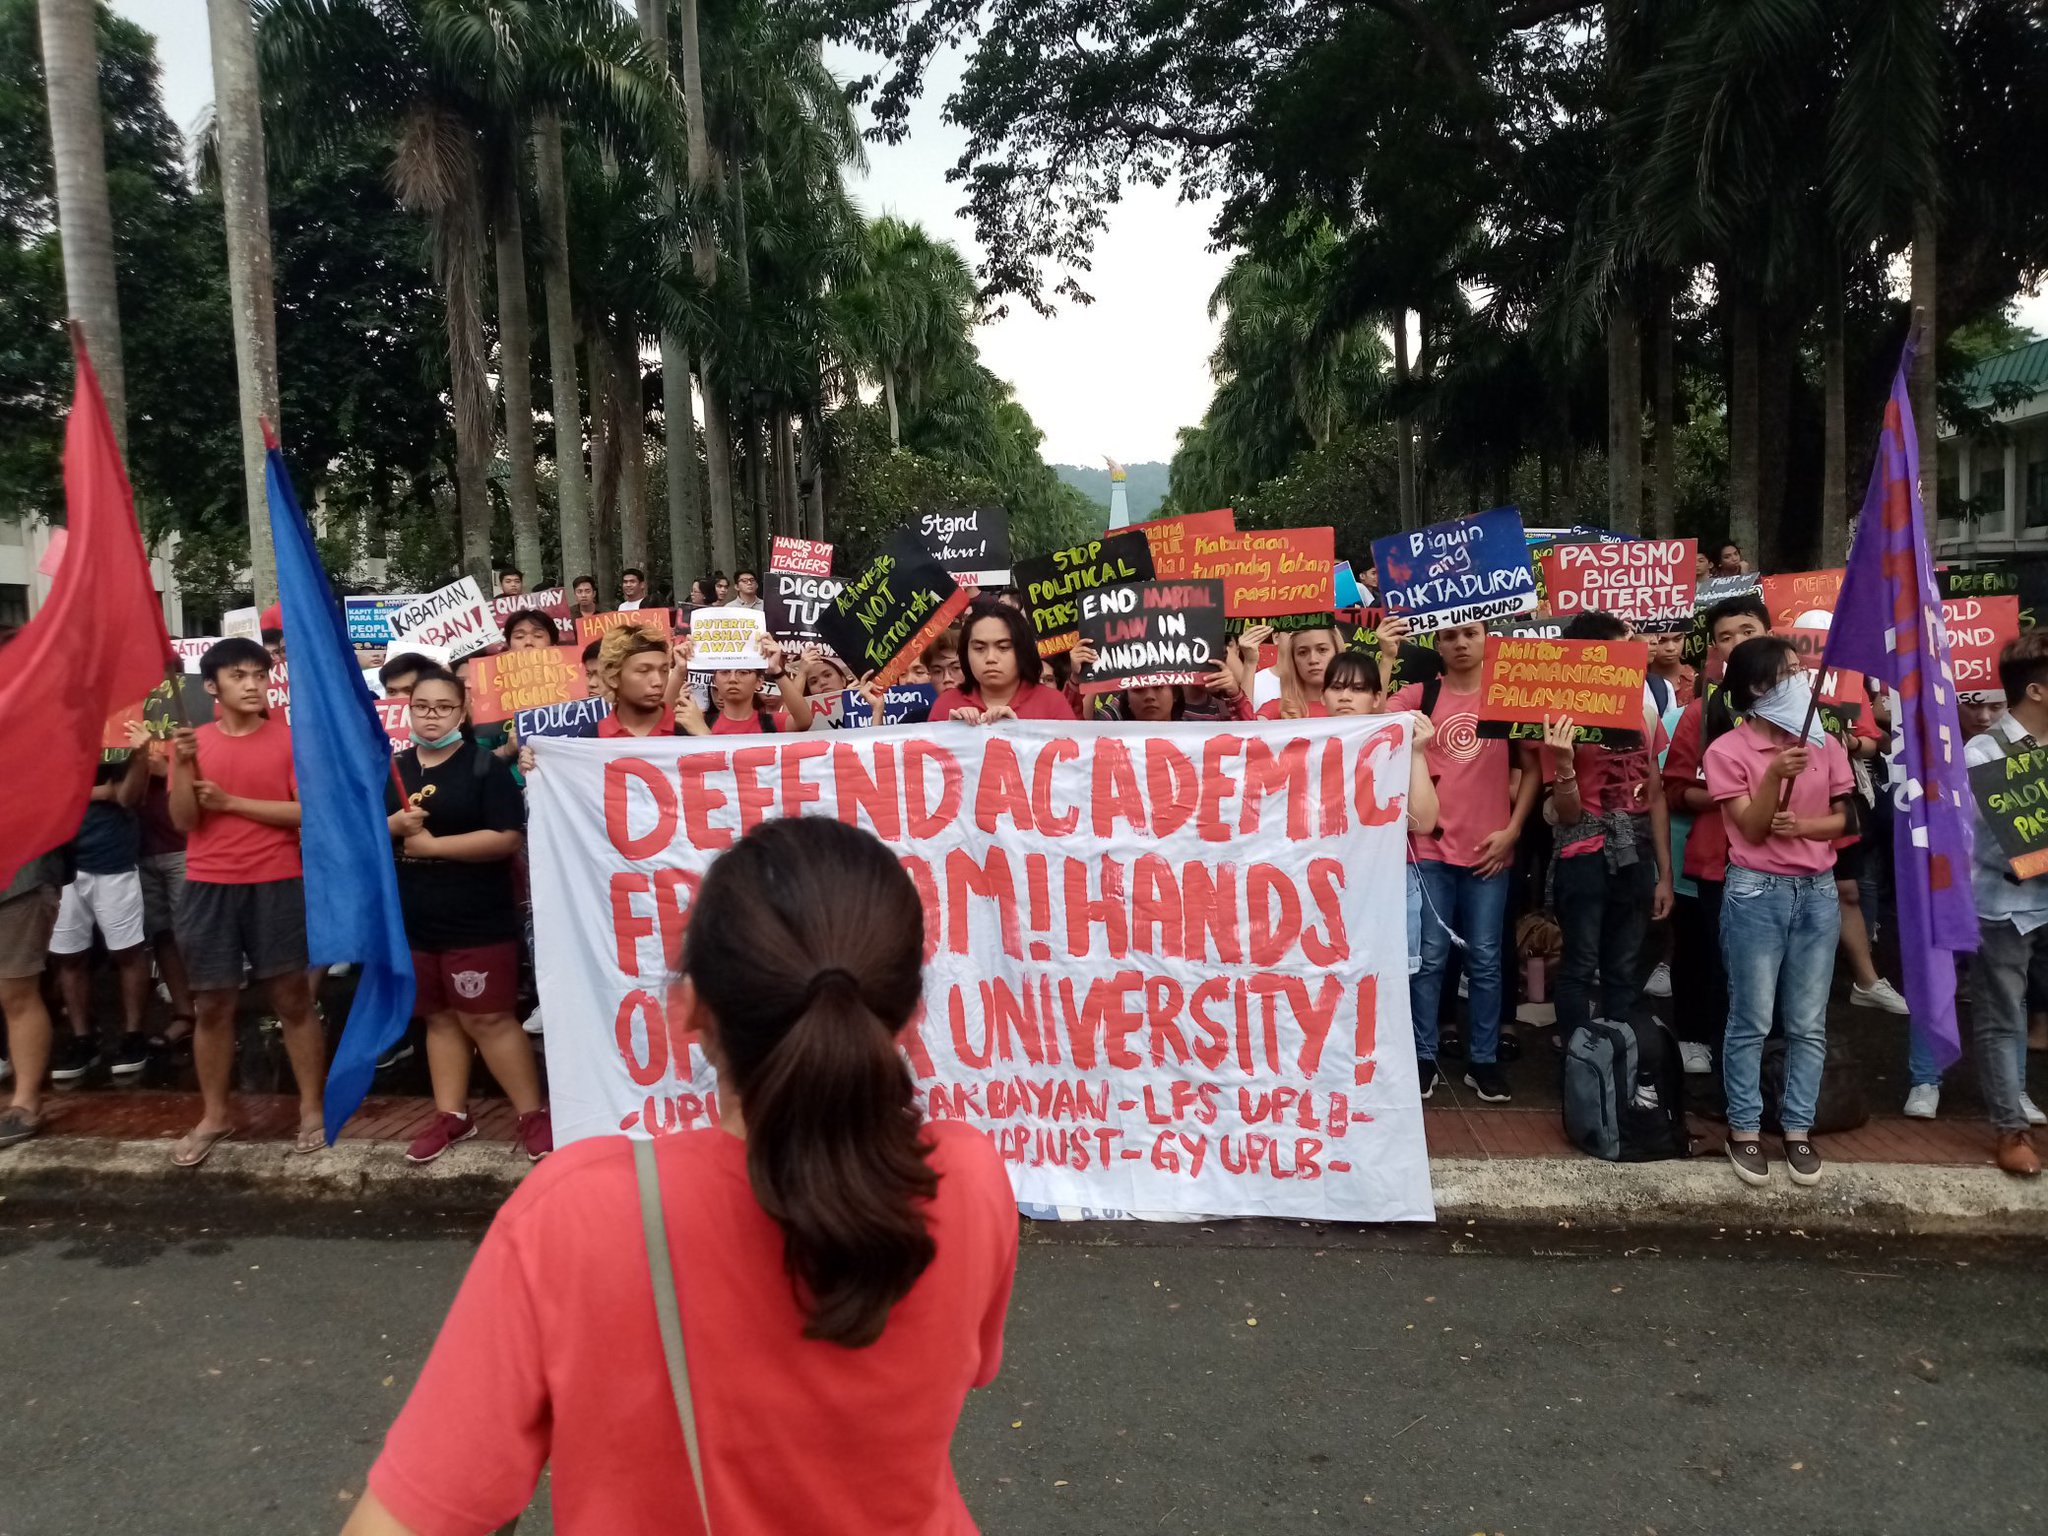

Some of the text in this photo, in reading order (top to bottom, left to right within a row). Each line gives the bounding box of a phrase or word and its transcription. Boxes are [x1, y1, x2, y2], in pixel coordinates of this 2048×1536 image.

[921, 511, 978, 536] Stand
[776, 537, 811, 551] HANDS
[1410, 522, 1483, 556] Biguin
[773, 555, 830, 573] TEACHERS
[792, 550, 808, 558] OUR
[1053, 541, 1101, 570] STOP
[1279, 552, 1330, 573] laban
[1428, 546, 1471, 578] ang
[1560, 541, 1685, 570] PASISMO
[1029, 558, 1136, 604] POLITICAL
[1385, 566, 1534, 614] DIKTADURYA
[1584, 564, 1674, 588] BIGUIN
[1950, 573, 2018, 591] DEFEND
[488, 590, 563, 616] EQUAL PAY
[856, 577, 895, 634] NOT
[1083, 588, 1138, 620] END
[1234, 578, 1327, 609] pasismo!
[1558, 585, 1688, 612] DUTERTE
[390, 582, 474, 637] KABATAAN,
[694, 619, 758, 629] DUTERTE,
[419, 606, 484, 647] ABAN!
[693, 630, 752, 641] SASHAY
[1105, 613, 1186, 642] LAW IN
[496, 649, 563, 673] UPHOLD
[700, 642, 746, 652] AWAY
[1093, 637, 1210, 673] MINDANAO
[1494, 661, 1644, 688] PAMANTASAN
[501, 682, 570, 711] RIGHTS
[1487, 684, 1627, 715] PALAYASIN!
[604, 722, 1406, 860] DEFEND ACADEMIC
[1063, 851, 1350, 967] HANDS
[948, 971, 1378, 1086] UNIVERSITY!
